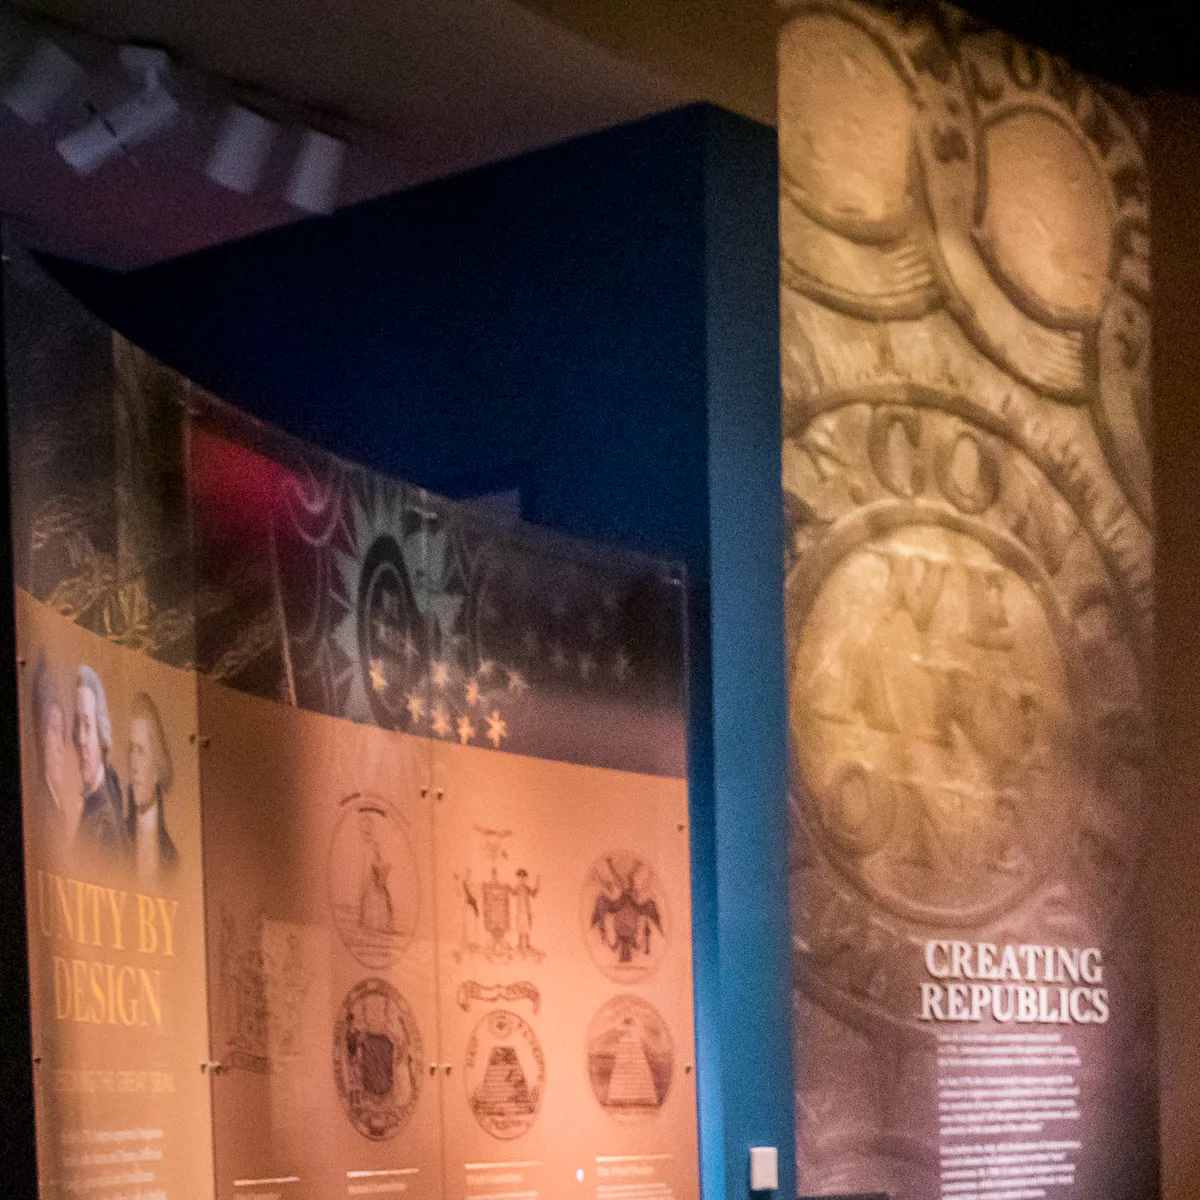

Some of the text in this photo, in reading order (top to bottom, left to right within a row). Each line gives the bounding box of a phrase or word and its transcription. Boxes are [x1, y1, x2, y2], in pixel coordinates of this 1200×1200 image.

[36, 869, 181, 957] UNITY BY
[925, 939, 1103, 983] CREATING
[53, 955, 166, 1028] DESIGN
[919, 982, 1110, 1024] REPUBLICS
